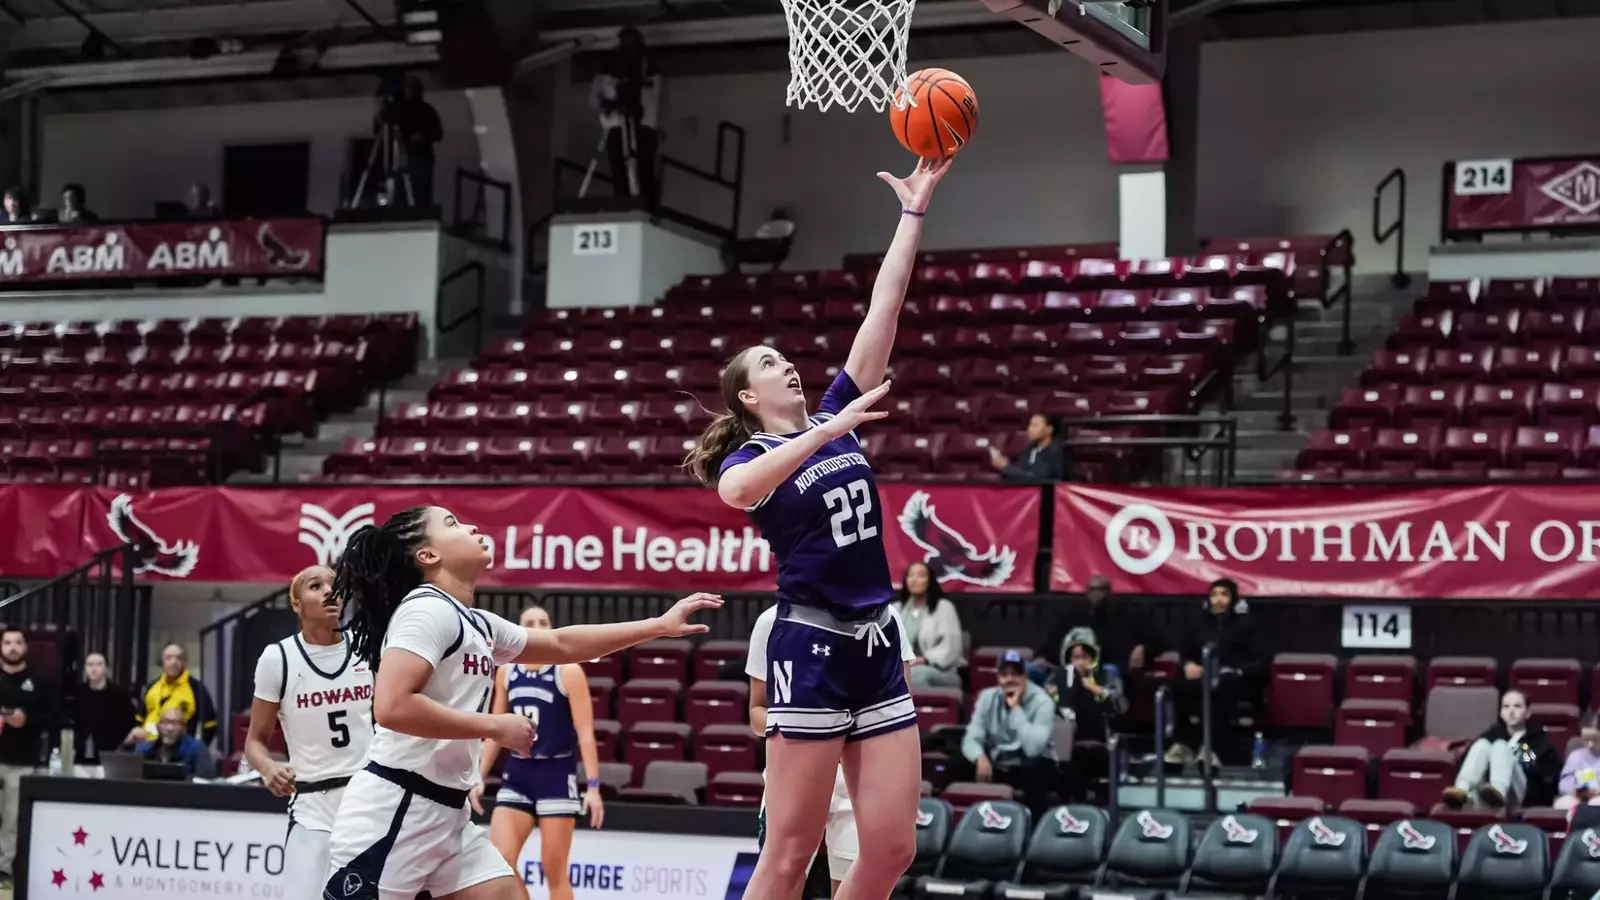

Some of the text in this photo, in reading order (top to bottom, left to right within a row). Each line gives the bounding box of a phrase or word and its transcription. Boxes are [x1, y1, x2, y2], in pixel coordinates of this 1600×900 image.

[1463, 166, 1506, 188] 214
[579, 230, 612, 250] 213
[46, 244, 125, 273] ABM
[147, 241, 229, 269] ABM
[822, 479, 878, 548] 22
[504, 524, 604, 571] Line
[612, 526, 771, 573] Health
[1127, 525, 1152, 550] R
[1185, 520, 1511, 562] ROTHMAN
[1353, 613, 1400, 638] 114
[297, 684, 372, 709] HOWARD
[773, 660, 793, 704] N
[327, 709, 351, 749] 5
[111, 835, 285, 875] VALLEY FO
[132, 876, 244, 896] MONTGOMERY
[631, 866, 708, 896] SPORTS
